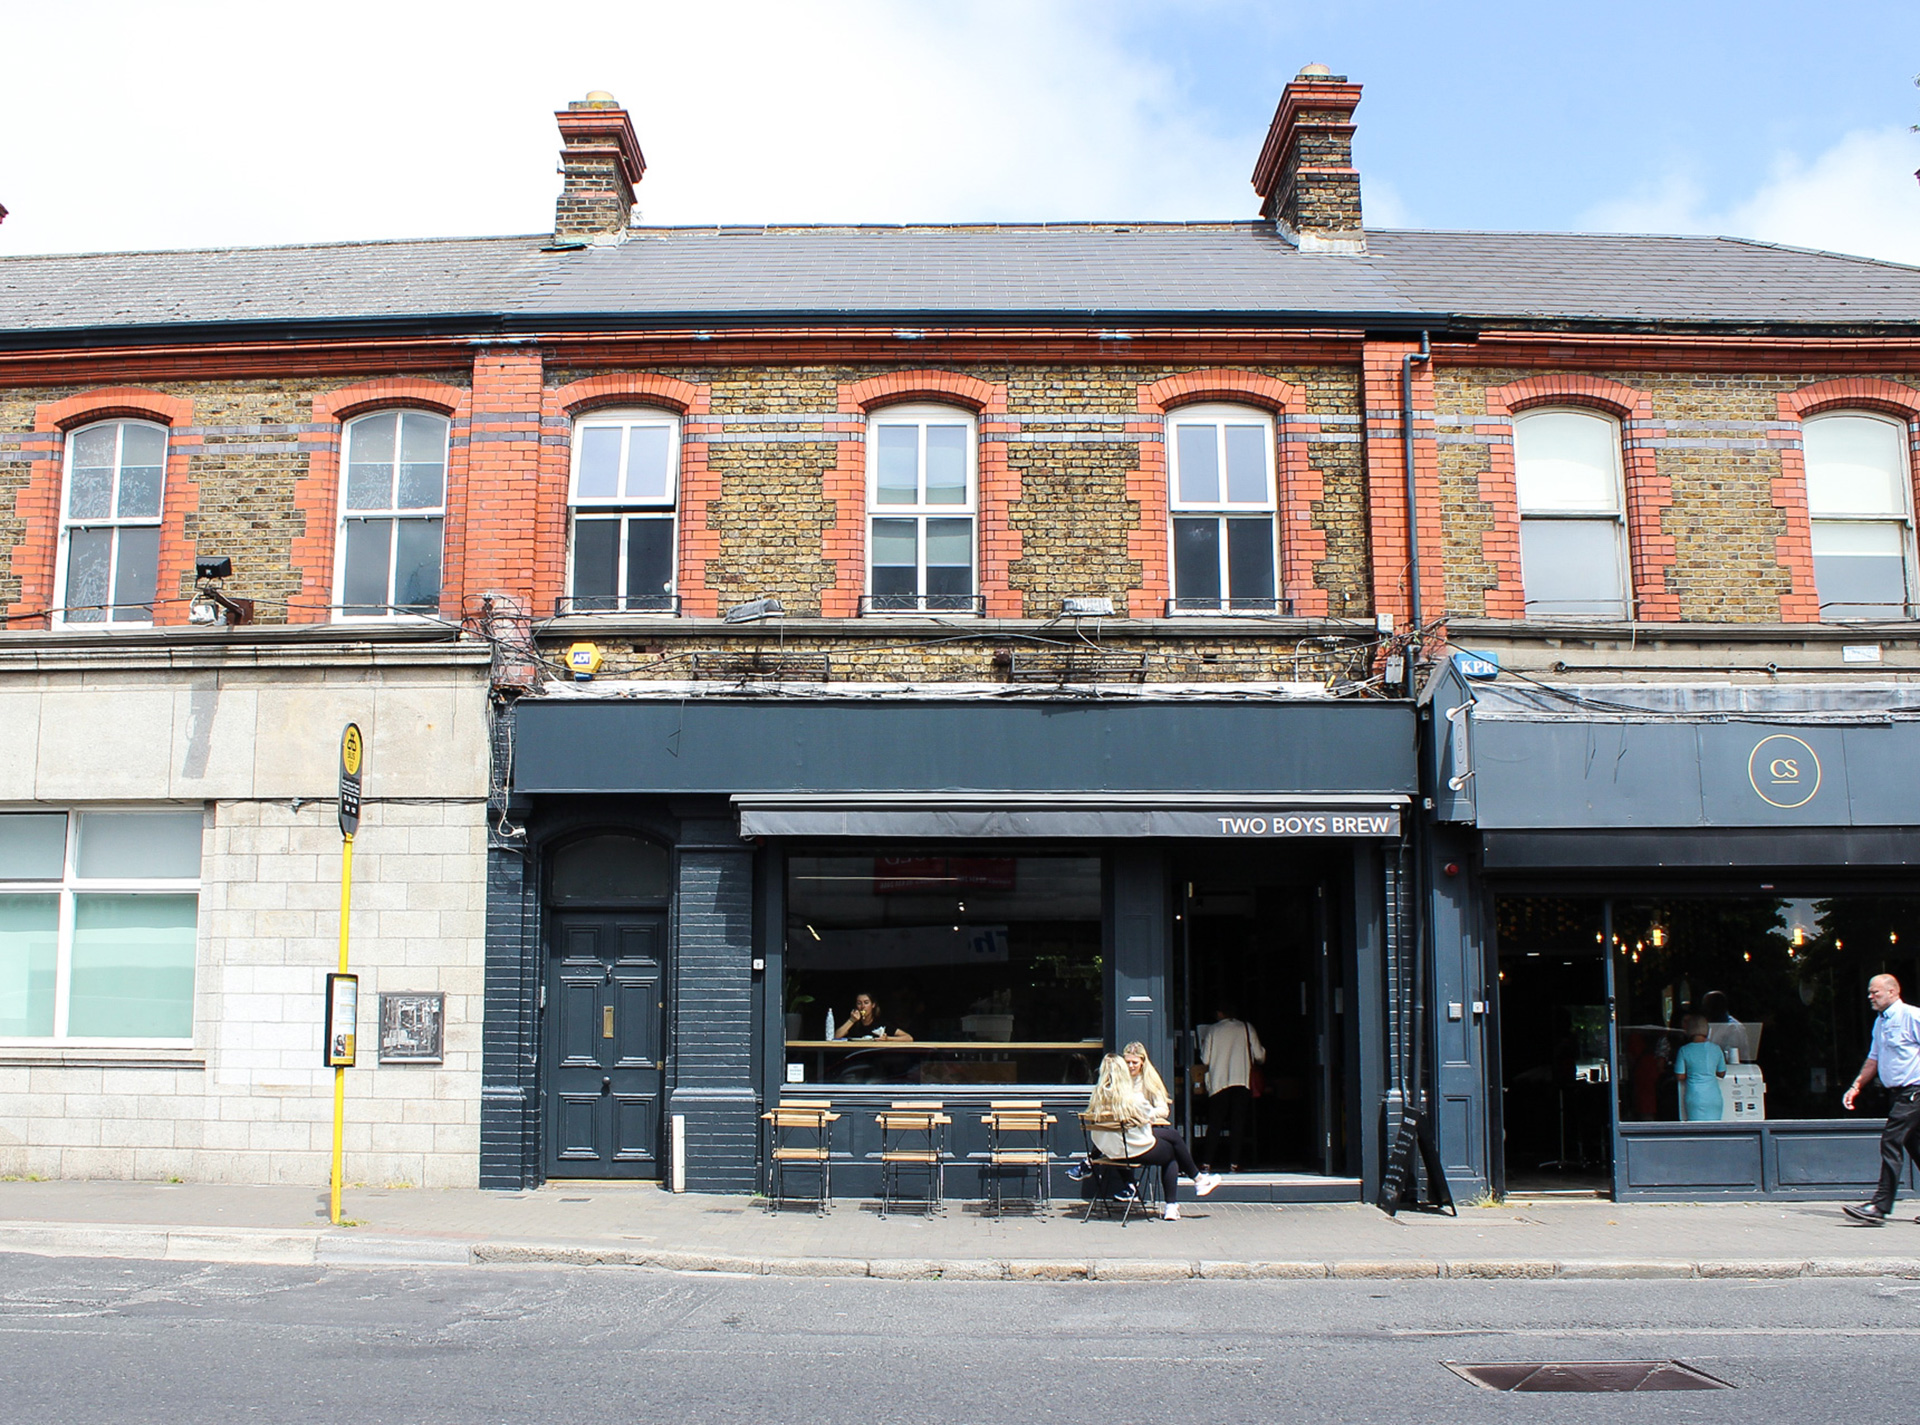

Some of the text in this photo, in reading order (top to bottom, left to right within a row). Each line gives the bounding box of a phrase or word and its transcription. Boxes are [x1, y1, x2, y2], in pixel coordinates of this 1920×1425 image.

[573, 653, 590, 664] ADT
[1461, 660, 1495, 674] KPR
[1770, 758, 1799, 778] CS
[1217, 817, 1389, 834] TWO BOYS BREW
